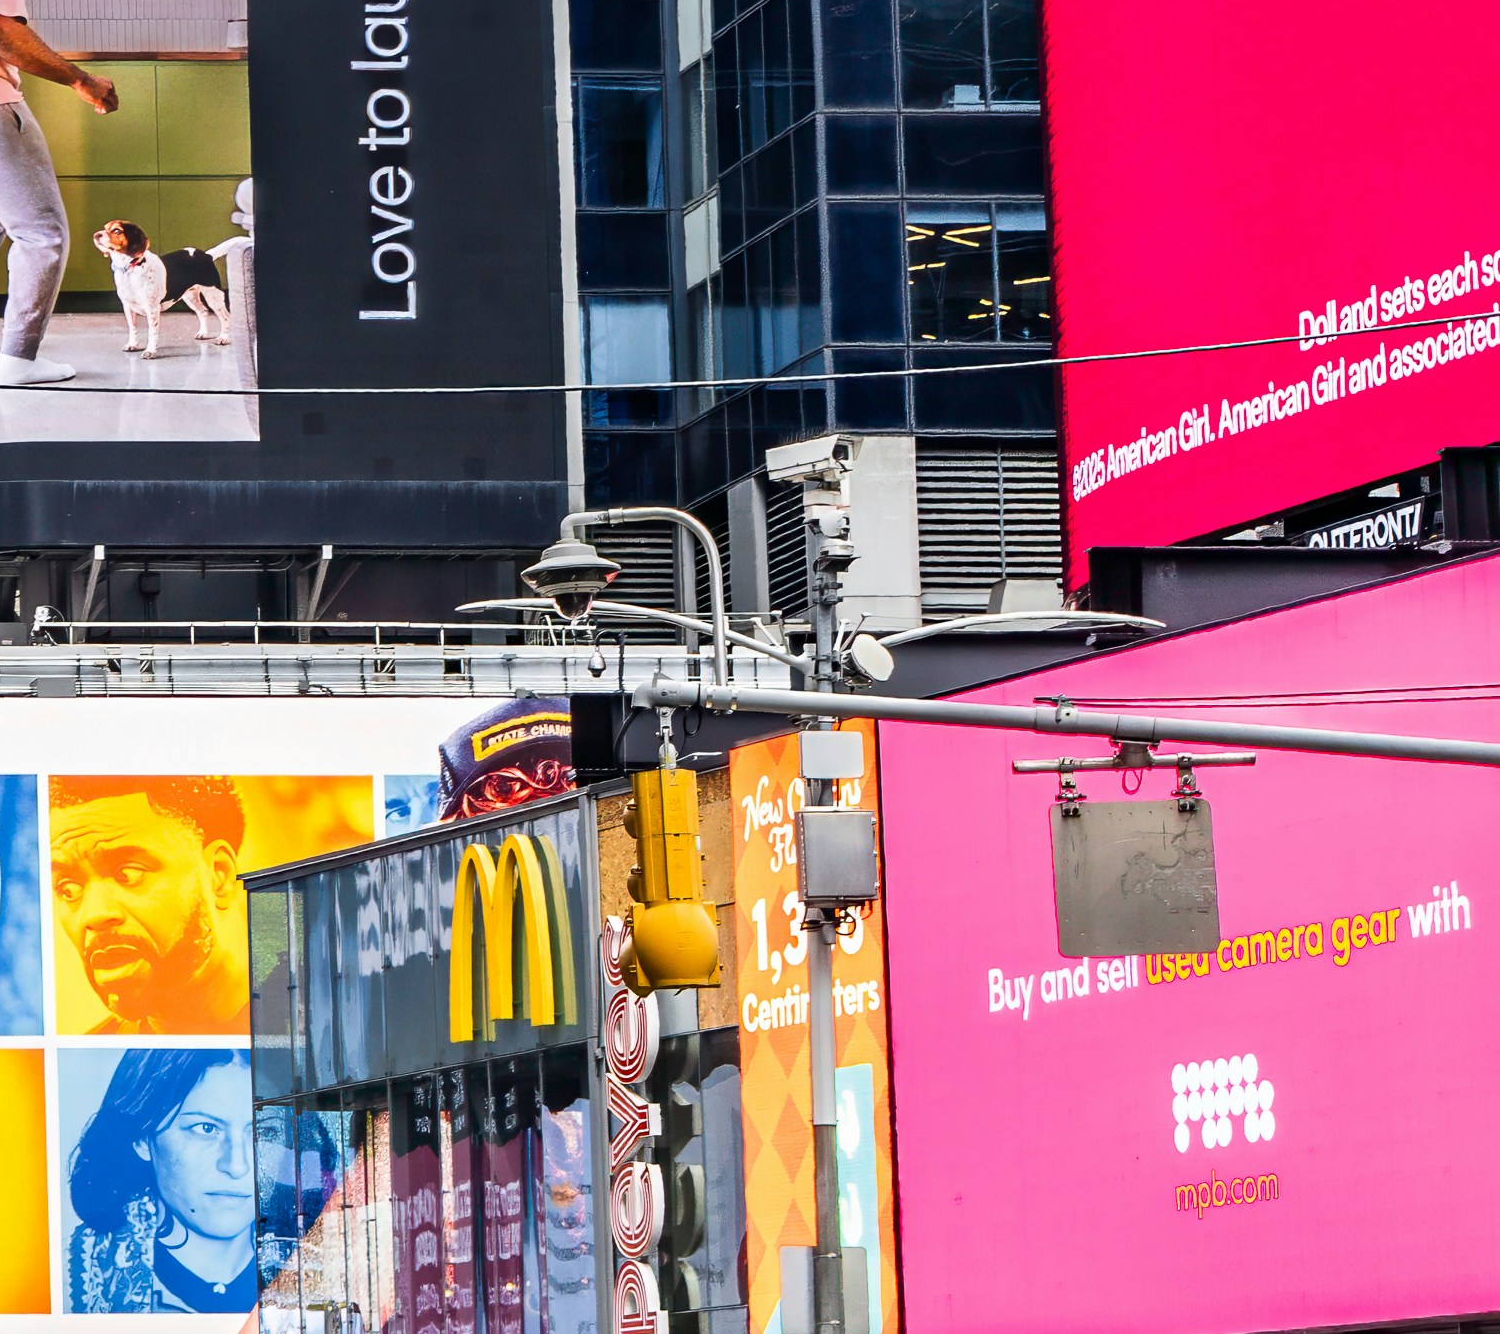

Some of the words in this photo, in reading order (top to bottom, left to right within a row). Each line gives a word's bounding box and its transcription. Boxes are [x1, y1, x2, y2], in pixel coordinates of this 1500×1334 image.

[357, 89, 414, 152] to
[357, 156, 416, 322] Love
[1299, 300, 1338, 352] Doll
[1339, 285, 1378, 331] and
[1381, 276, 1424, 321] sets
[1427, 251, 1479, 306] each
[1107, 422, 1178, 481] American
[1219, 381, 1309, 439] American
[1312, 357, 1345, 406] Girl
[1348, 342, 1387, 395] and
[741, 775, 782, 842] New
[989, 968, 1033, 1020] Buy
[1041, 959, 1090, 1004] and
[1096, 956, 1139, 994] sell
[1217, 921, 1324, 972] camera
[1332, 907, 1400, 966] gear
[1407, 882, 1470, 937] with
[1175, 1171, 1279, 1220] mpb.com
